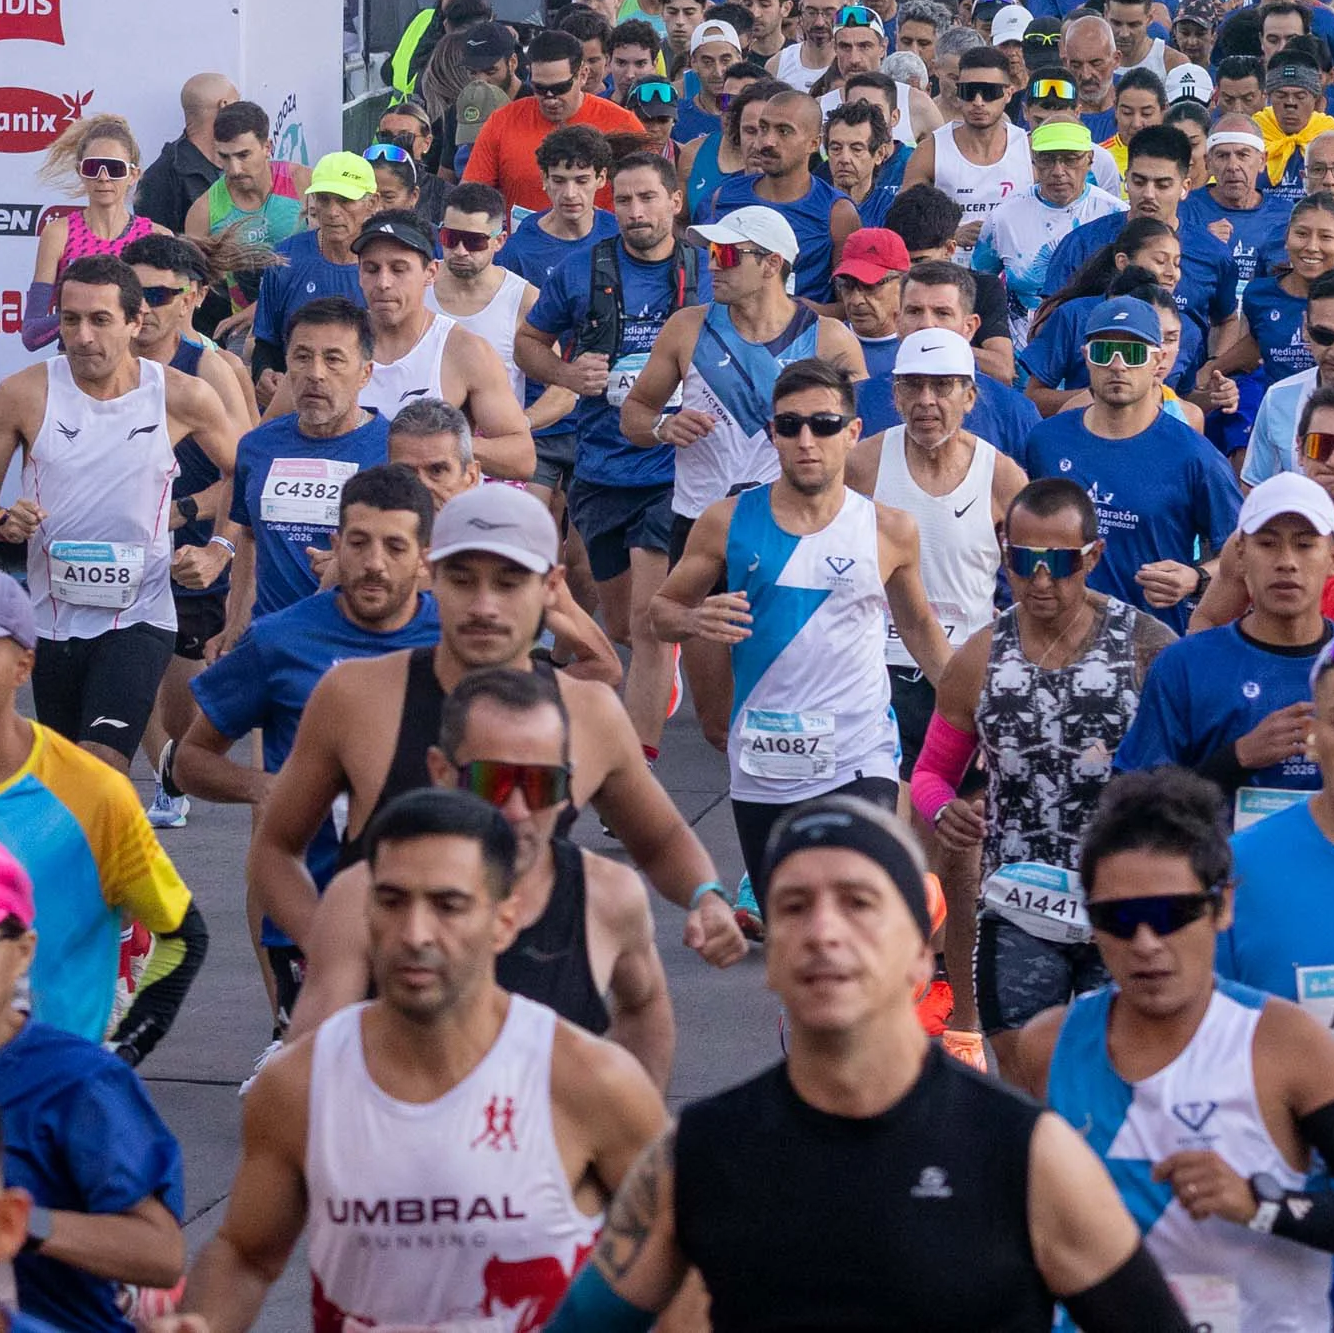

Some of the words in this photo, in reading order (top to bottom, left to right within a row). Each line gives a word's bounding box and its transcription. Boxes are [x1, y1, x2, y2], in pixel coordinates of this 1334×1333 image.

[959, 203, 986, 212] ACER
[700, 386, 733, 427] VICTORY
[274, 481, 340, 500] C4382
[1095, 508, 1139, 523] Maratón
[287, 533, 313, 542] 2026
[64, 566, 131, 584] A1058
[751, 737, 819, 755] A1087
[1005, 887, 1078, 919] A1441
[327, 1195, 527, 1225] UMBRAL
[355, 1232, 487, 1252] RUNNING
